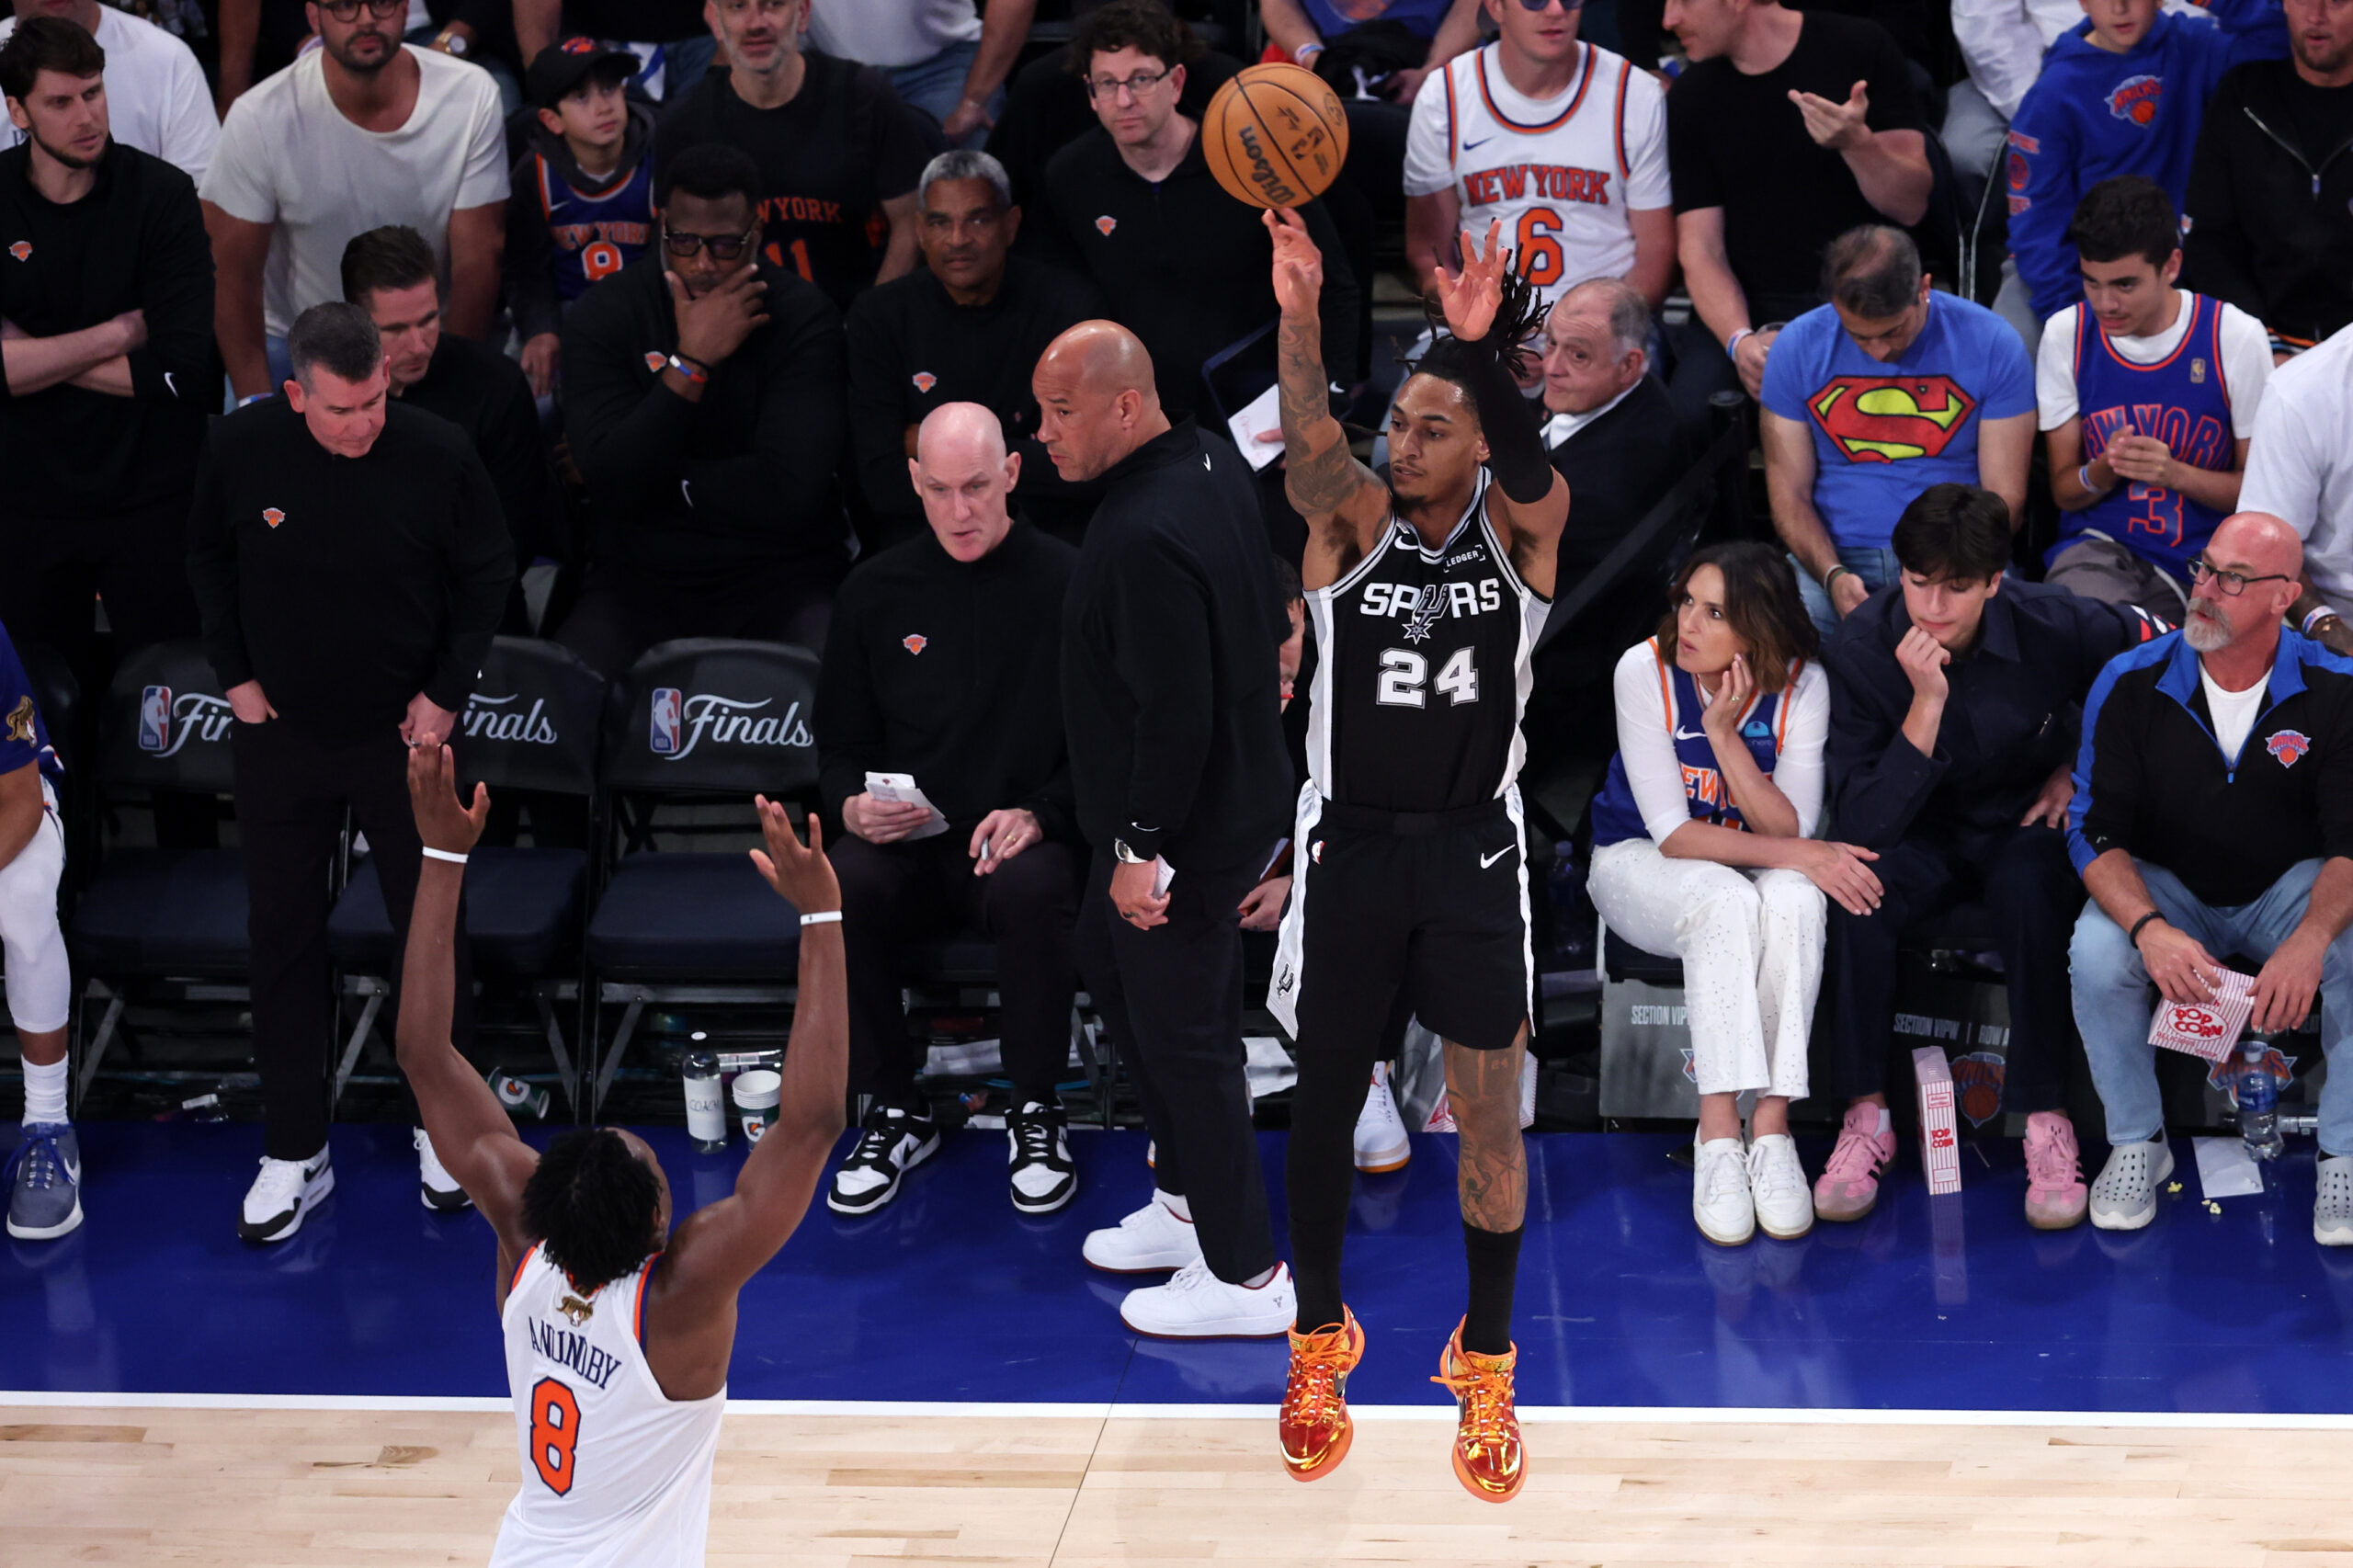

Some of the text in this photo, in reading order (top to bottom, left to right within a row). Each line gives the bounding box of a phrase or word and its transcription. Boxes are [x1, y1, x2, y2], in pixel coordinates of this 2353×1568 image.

[1238, 125, 1297, 205] Wilson
[1463, 164, 1611, 208] NEW YORK
[773, 195, 843, 223] YORK
[1517, 207, 1564, 287] 6
[1446, 550, 1479, 567] LEDGER
[1359, 577, 1501, 644] SPURS
[1376, 645, 1479, 710] 24
[462, 692, 558, 744] inals
[664, 693, 814, 761] Finals
[1680, 761, 1719, 807] EW
[1631, 1005, 1670, 1026] SECTION
[1893, 1013, 1933, 1037] SECTION
[1978, 1024, 2004, 1046] ROW
[2174, 1020, 2223, 1038] CORN
[2175, 1007, 2213, 1025] POP
[1932, 1128, 1950, 1140] POP
[529, 1375, 582, 1498] 8
